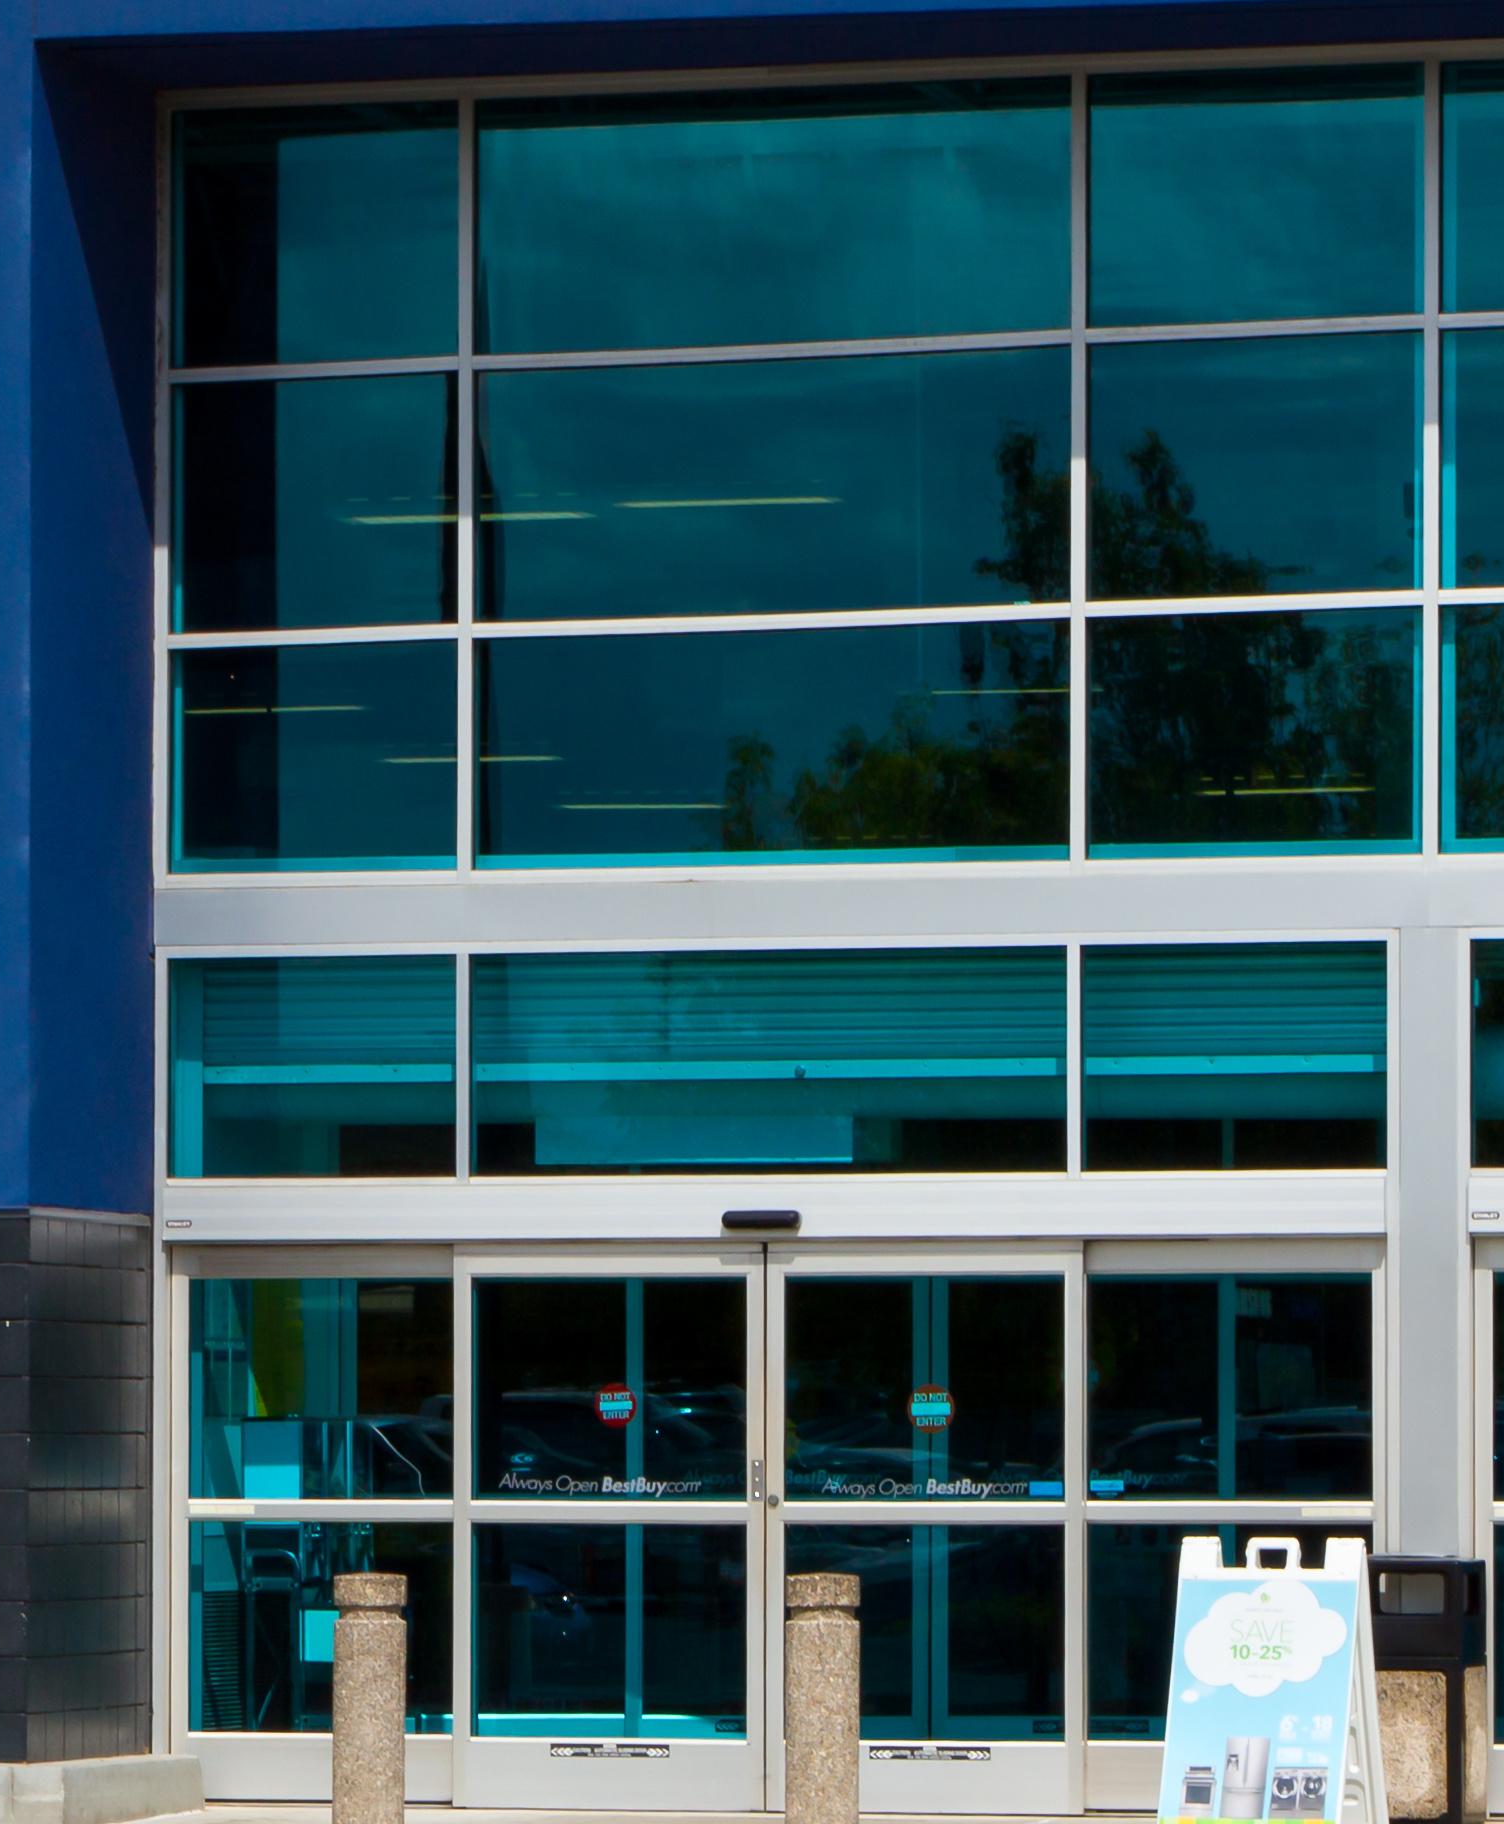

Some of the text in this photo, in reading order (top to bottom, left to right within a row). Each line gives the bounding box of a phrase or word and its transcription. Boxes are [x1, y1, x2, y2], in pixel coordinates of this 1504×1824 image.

[914, 1392, 948, 1402] DO NOT
[916, 1416, 946, 1427] ENTER
[498, 1473, 553, 1495] Always
[555, 1475, 599, 1495] Open
[821, 1476, 876, 1498] Always
[878, 1478, 923, 1497] Open
[1230, 1618, 1296, 1643] SAVE
